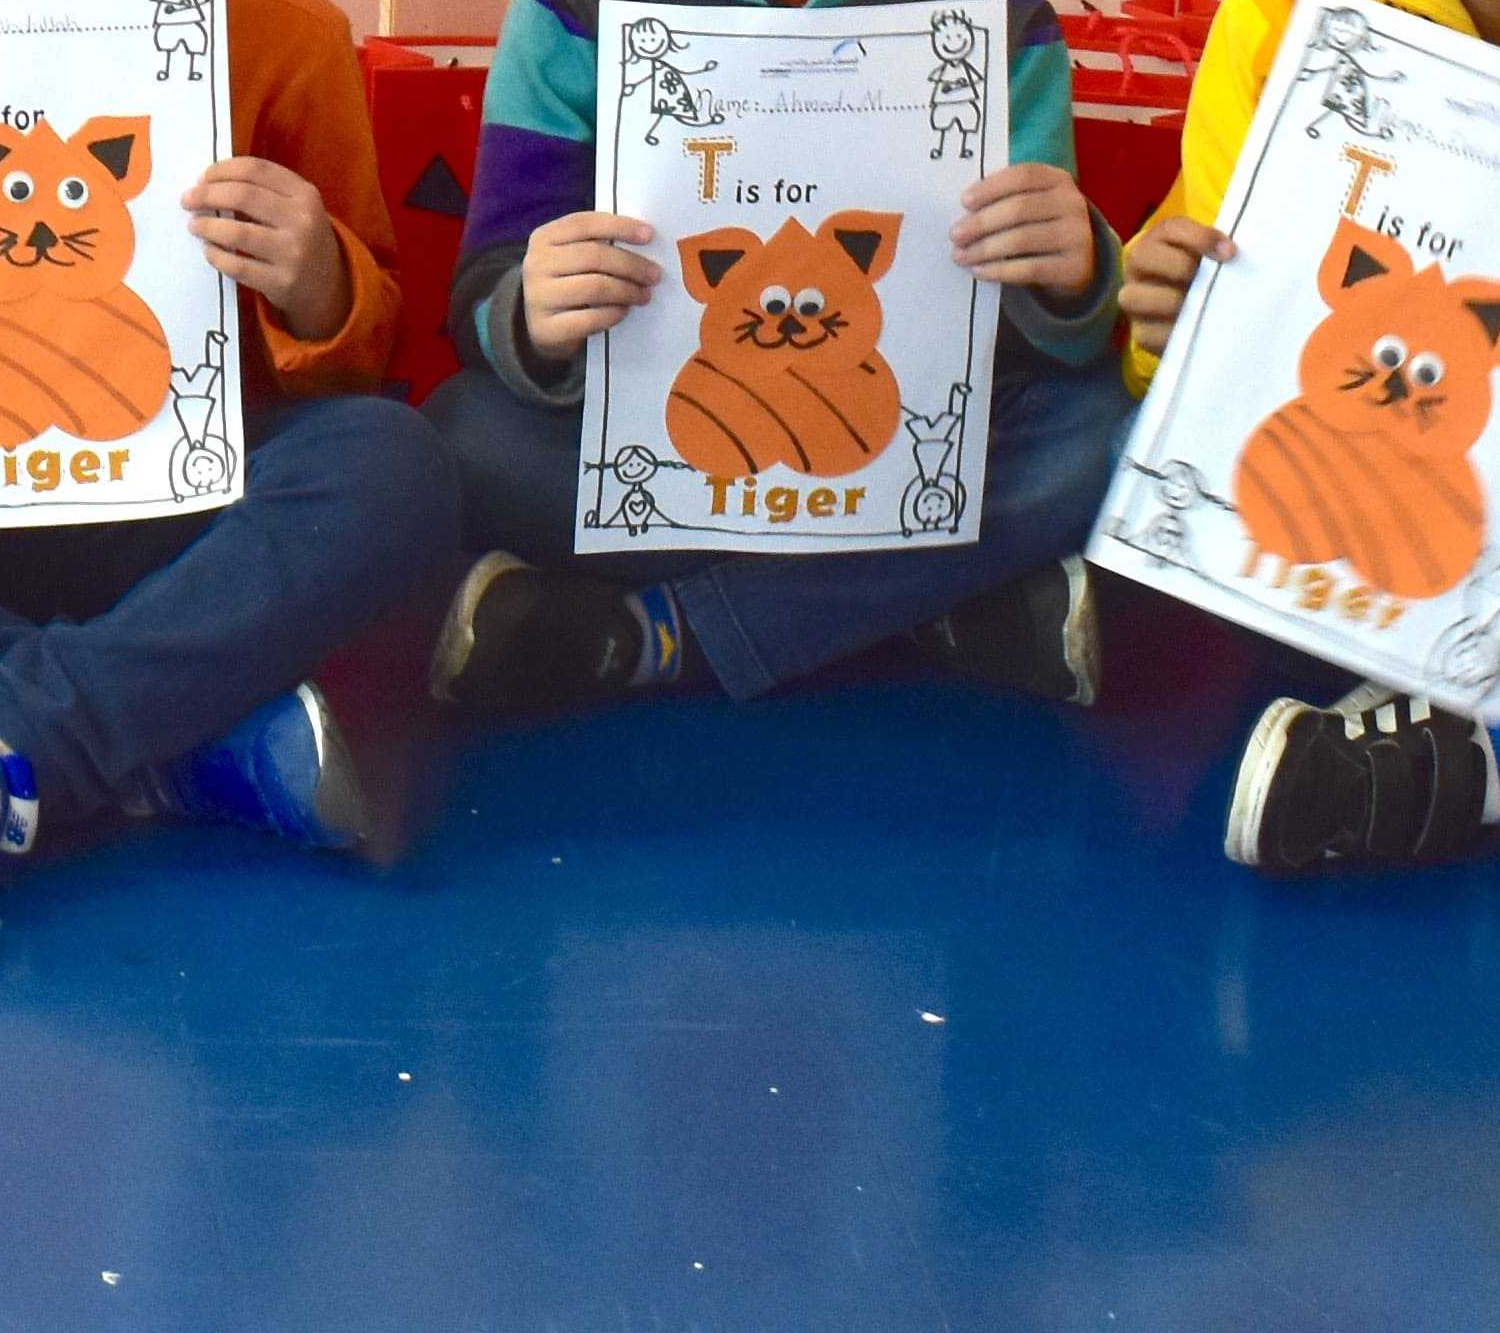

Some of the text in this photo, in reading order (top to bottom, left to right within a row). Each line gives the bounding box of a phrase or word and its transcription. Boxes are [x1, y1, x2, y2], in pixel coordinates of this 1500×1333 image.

[1, 104, 45, 130] for
[685, 139, 818, 203] T is for
[1341, 143, 1464, 261] T is for
[704, 476, 866, 523] Tiger
